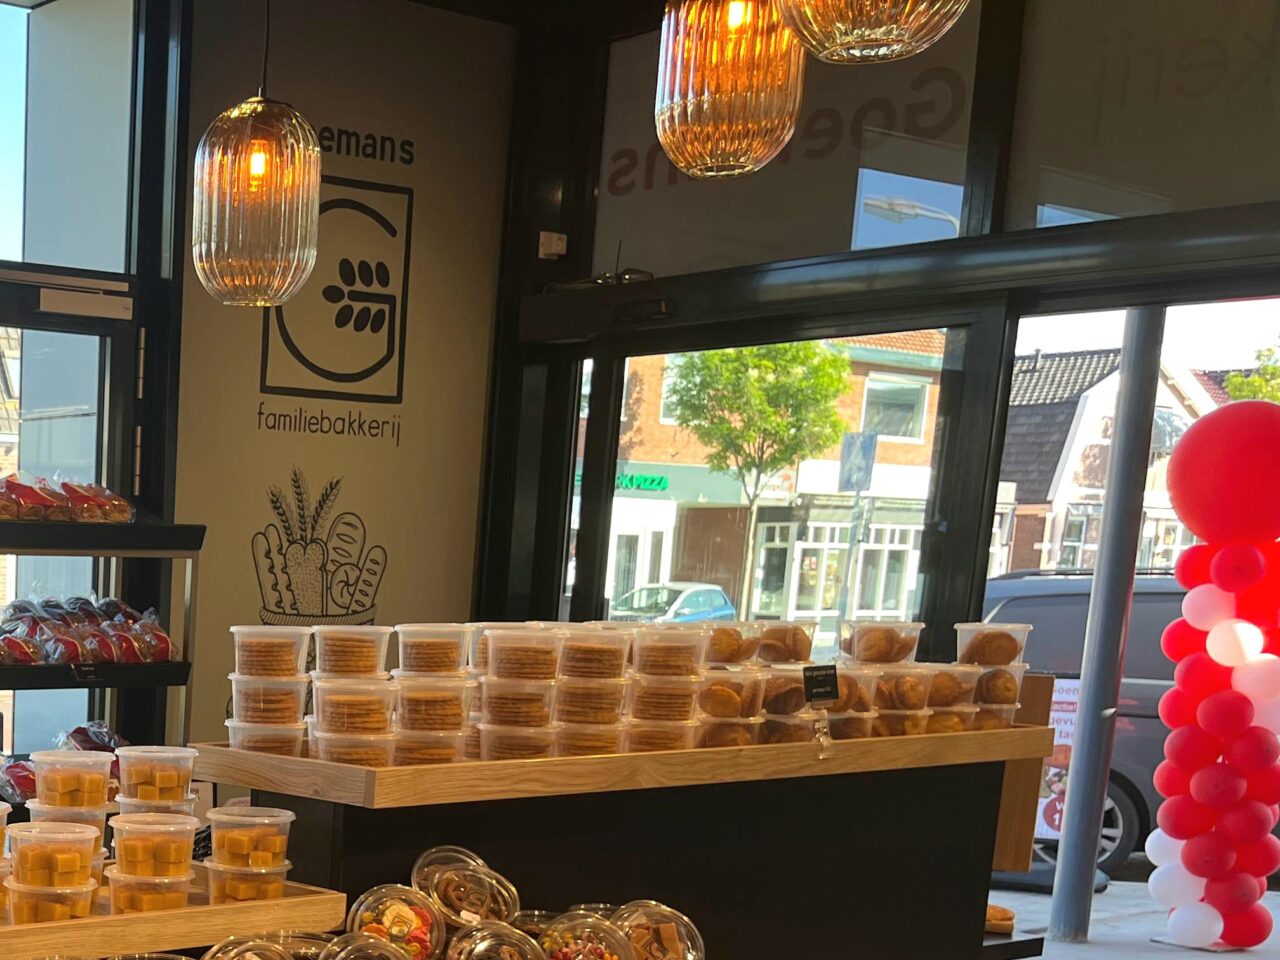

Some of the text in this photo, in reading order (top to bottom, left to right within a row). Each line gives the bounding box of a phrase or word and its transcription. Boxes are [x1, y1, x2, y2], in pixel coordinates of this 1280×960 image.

[320, 124, 415, 166] emans
[256, 402, 401, 447] familiebakkerij
[633, 473, 669, 490] PIZZA
